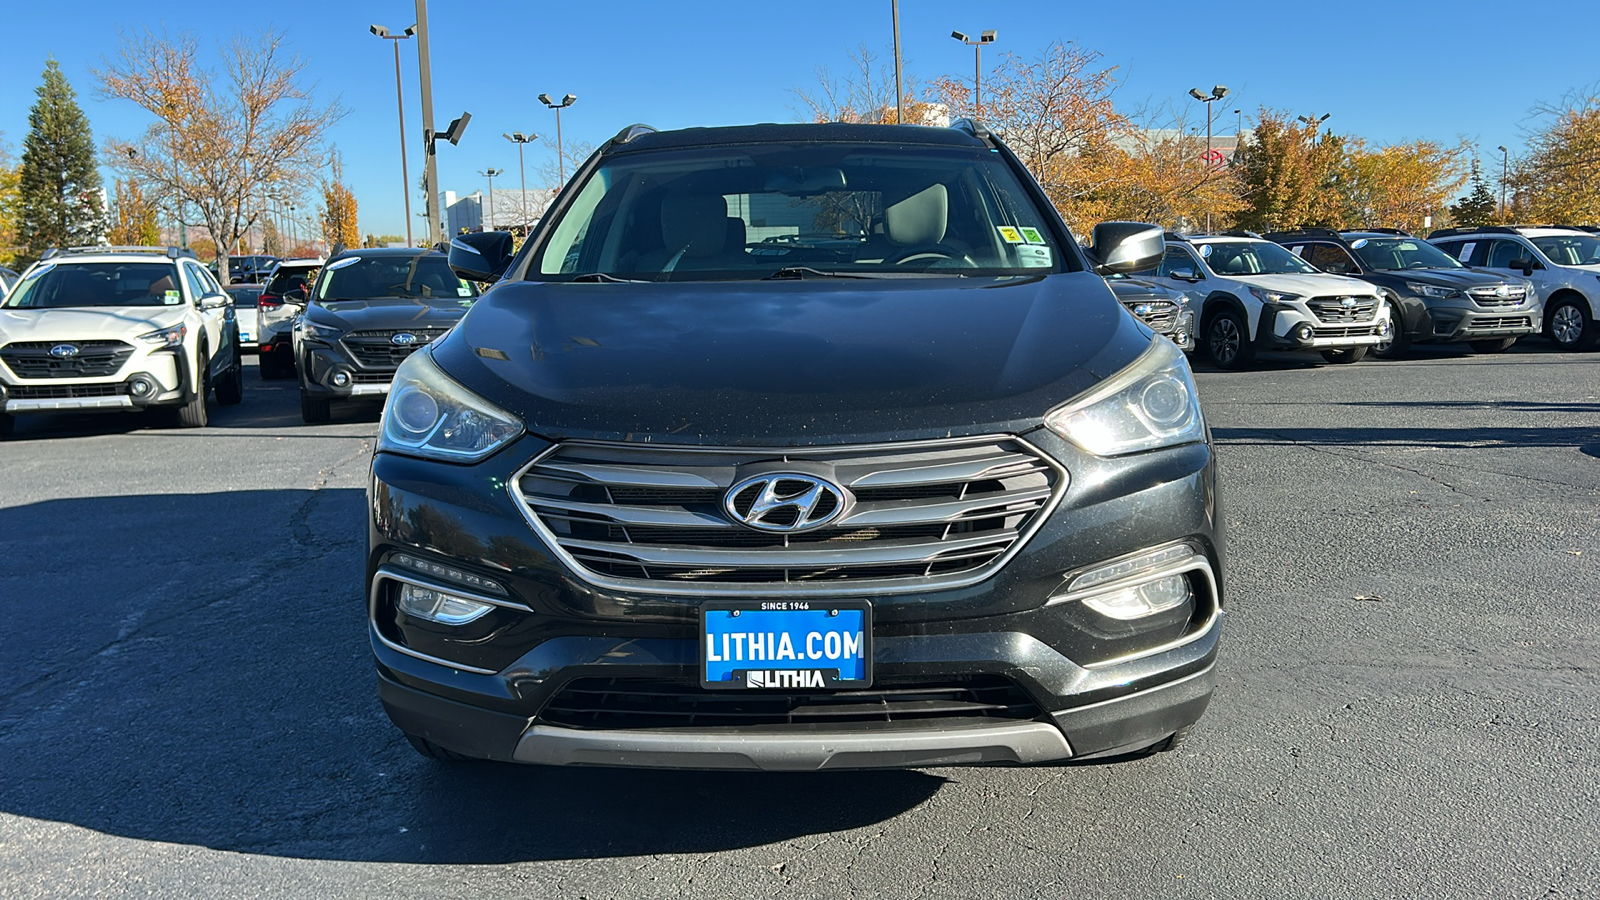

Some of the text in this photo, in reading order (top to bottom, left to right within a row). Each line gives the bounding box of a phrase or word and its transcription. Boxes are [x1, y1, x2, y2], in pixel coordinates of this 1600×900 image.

[761, 602, 810, 610] SINCE 1946
[706, 631, 865, 662] LITHIA.COM
[765, 670, 825, 688] LITHIA
